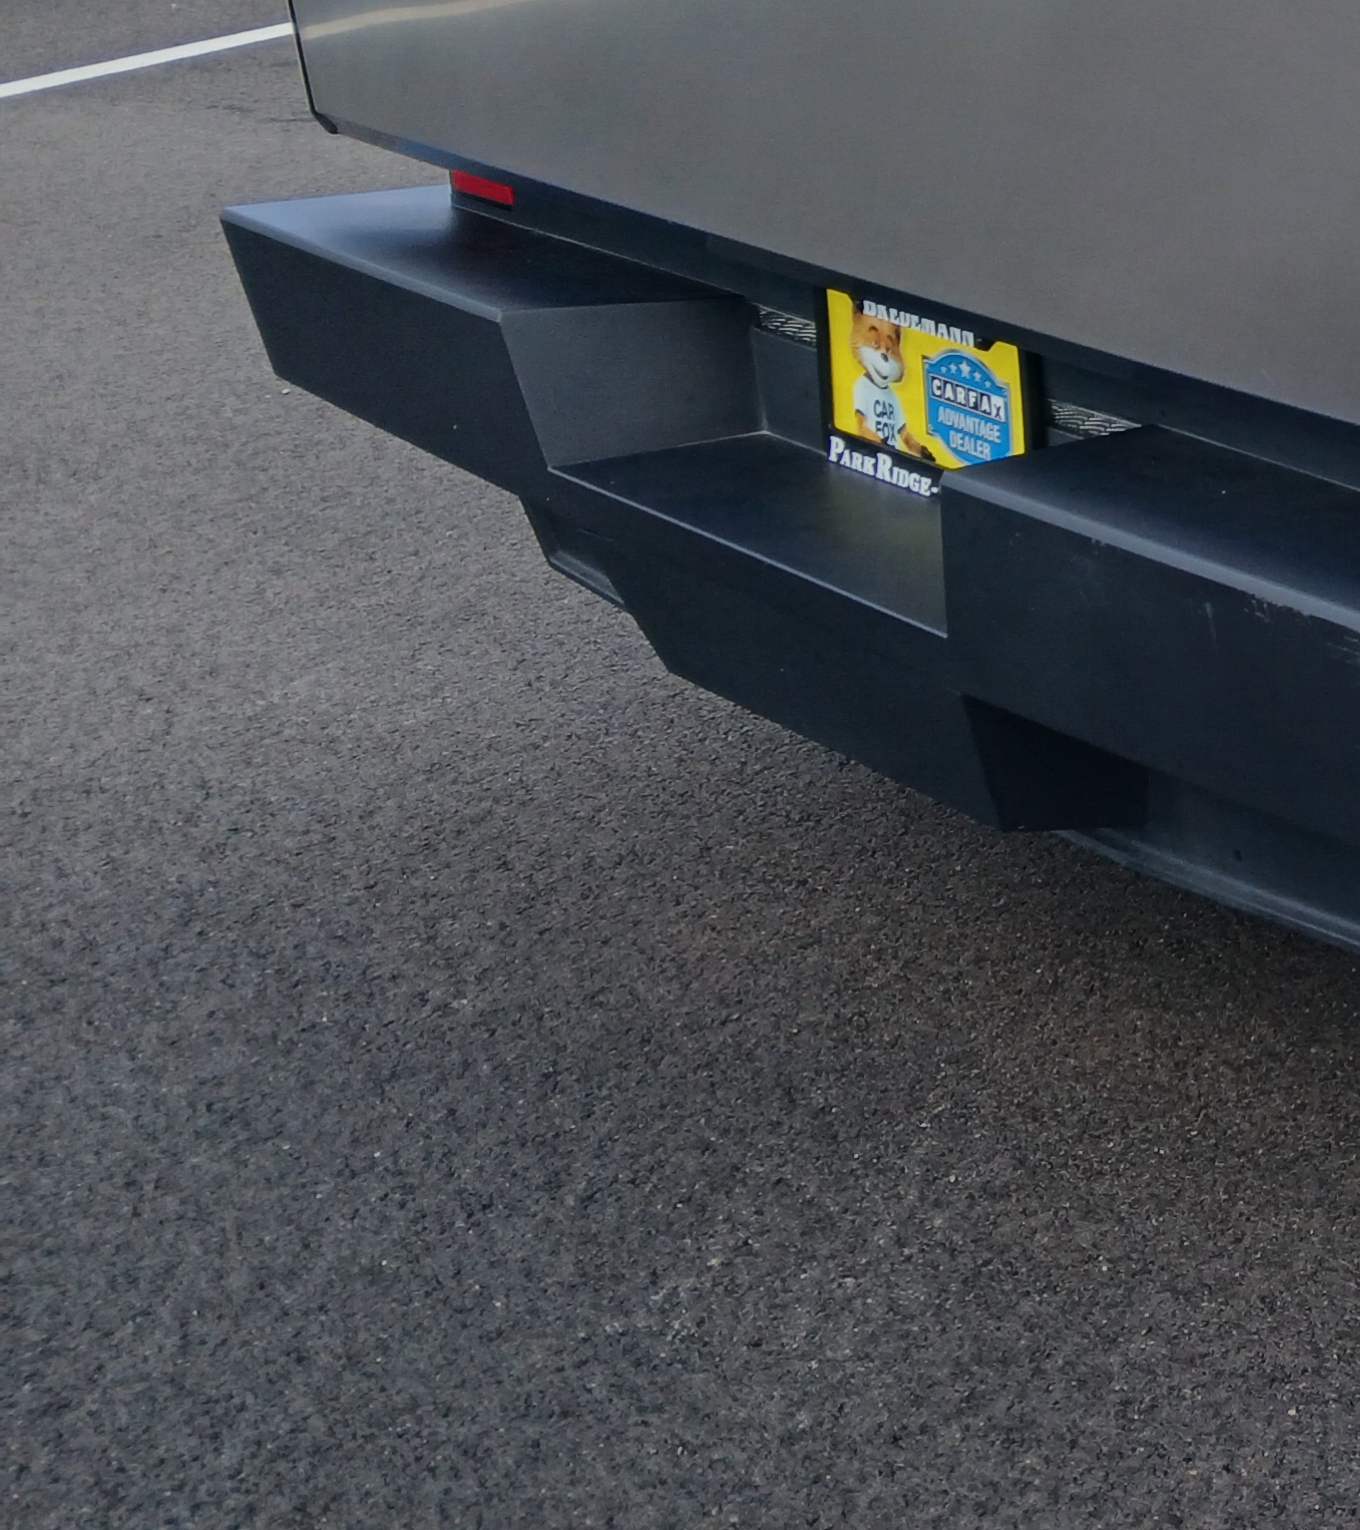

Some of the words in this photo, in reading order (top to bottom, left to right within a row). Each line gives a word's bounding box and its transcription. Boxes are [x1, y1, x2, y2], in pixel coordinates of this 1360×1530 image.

[874, 399, 895, 420] CAR
[932, 377, 1003, 420] CARFAX
[875, 420, 897, 442] FOX
[937, 406, 1002, 443] ADVANTAGE
[949, 430, 991, 461] DEALER
